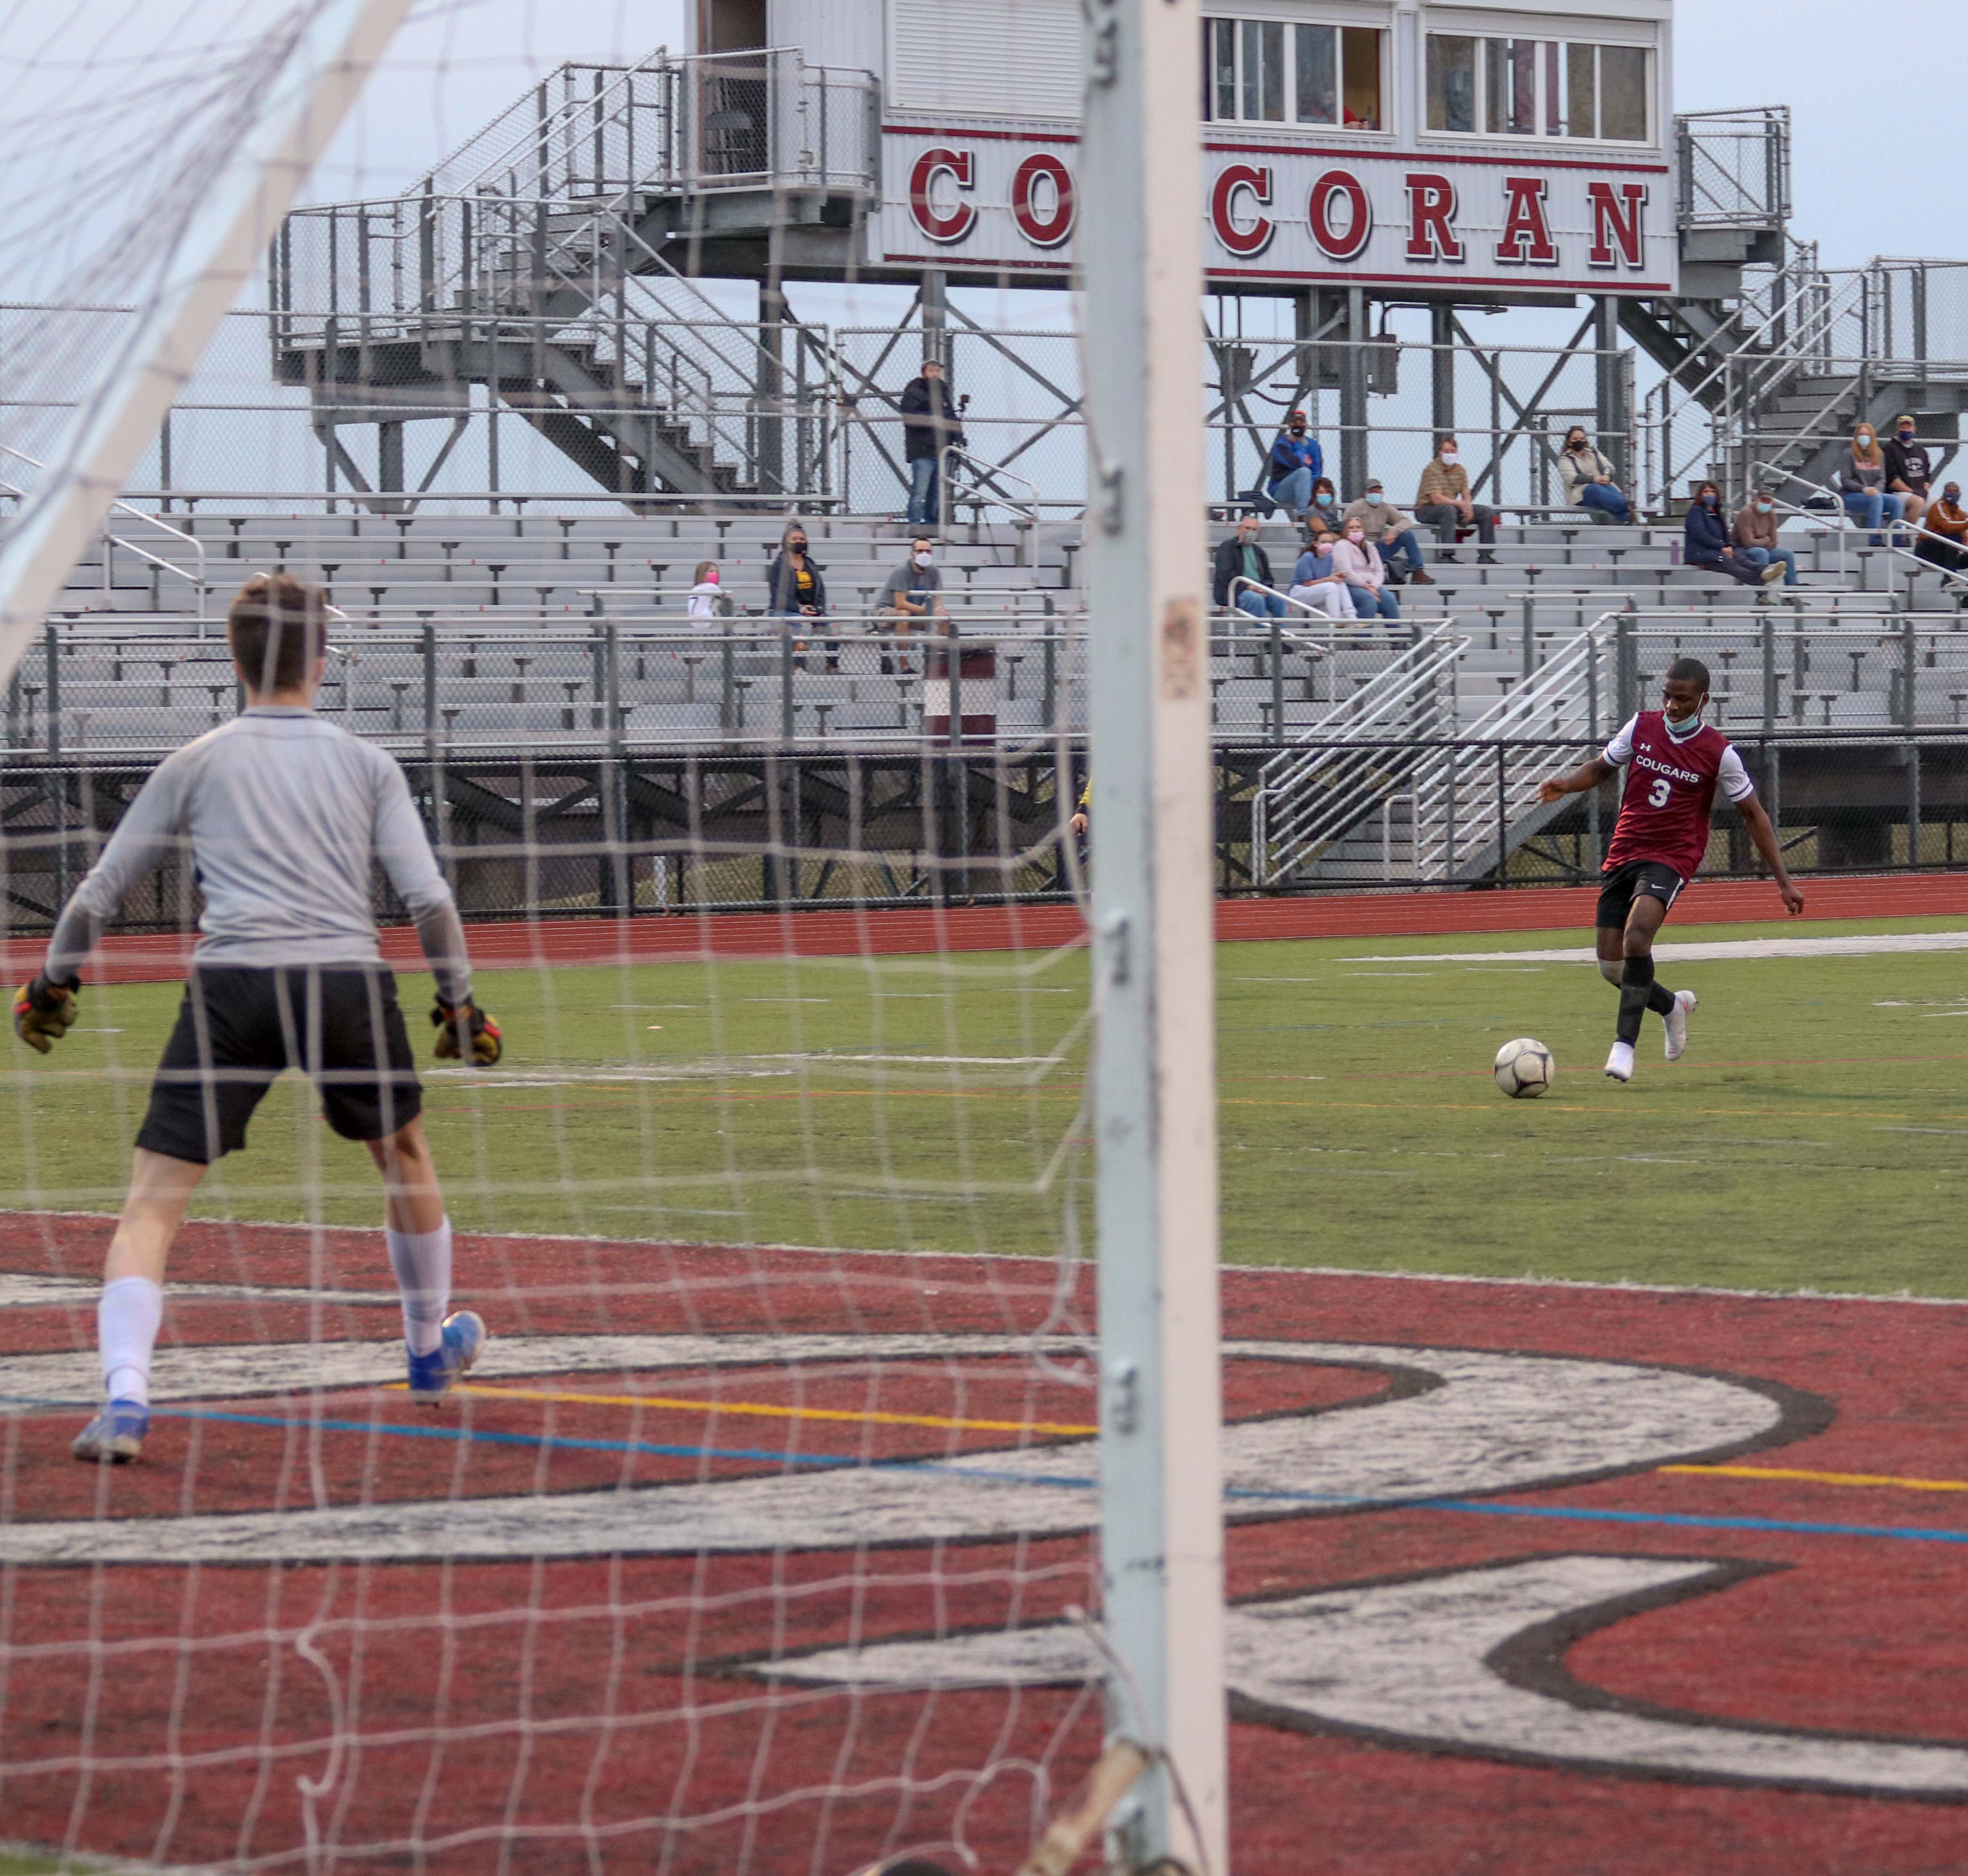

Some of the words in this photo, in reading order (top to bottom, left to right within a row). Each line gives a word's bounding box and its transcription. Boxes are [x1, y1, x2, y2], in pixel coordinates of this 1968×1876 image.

[909, 146, 1646, 270] COCORAN
[1636, 755, 1700, 783] COUGARS
[1648, 778, 1671, 808] 3
